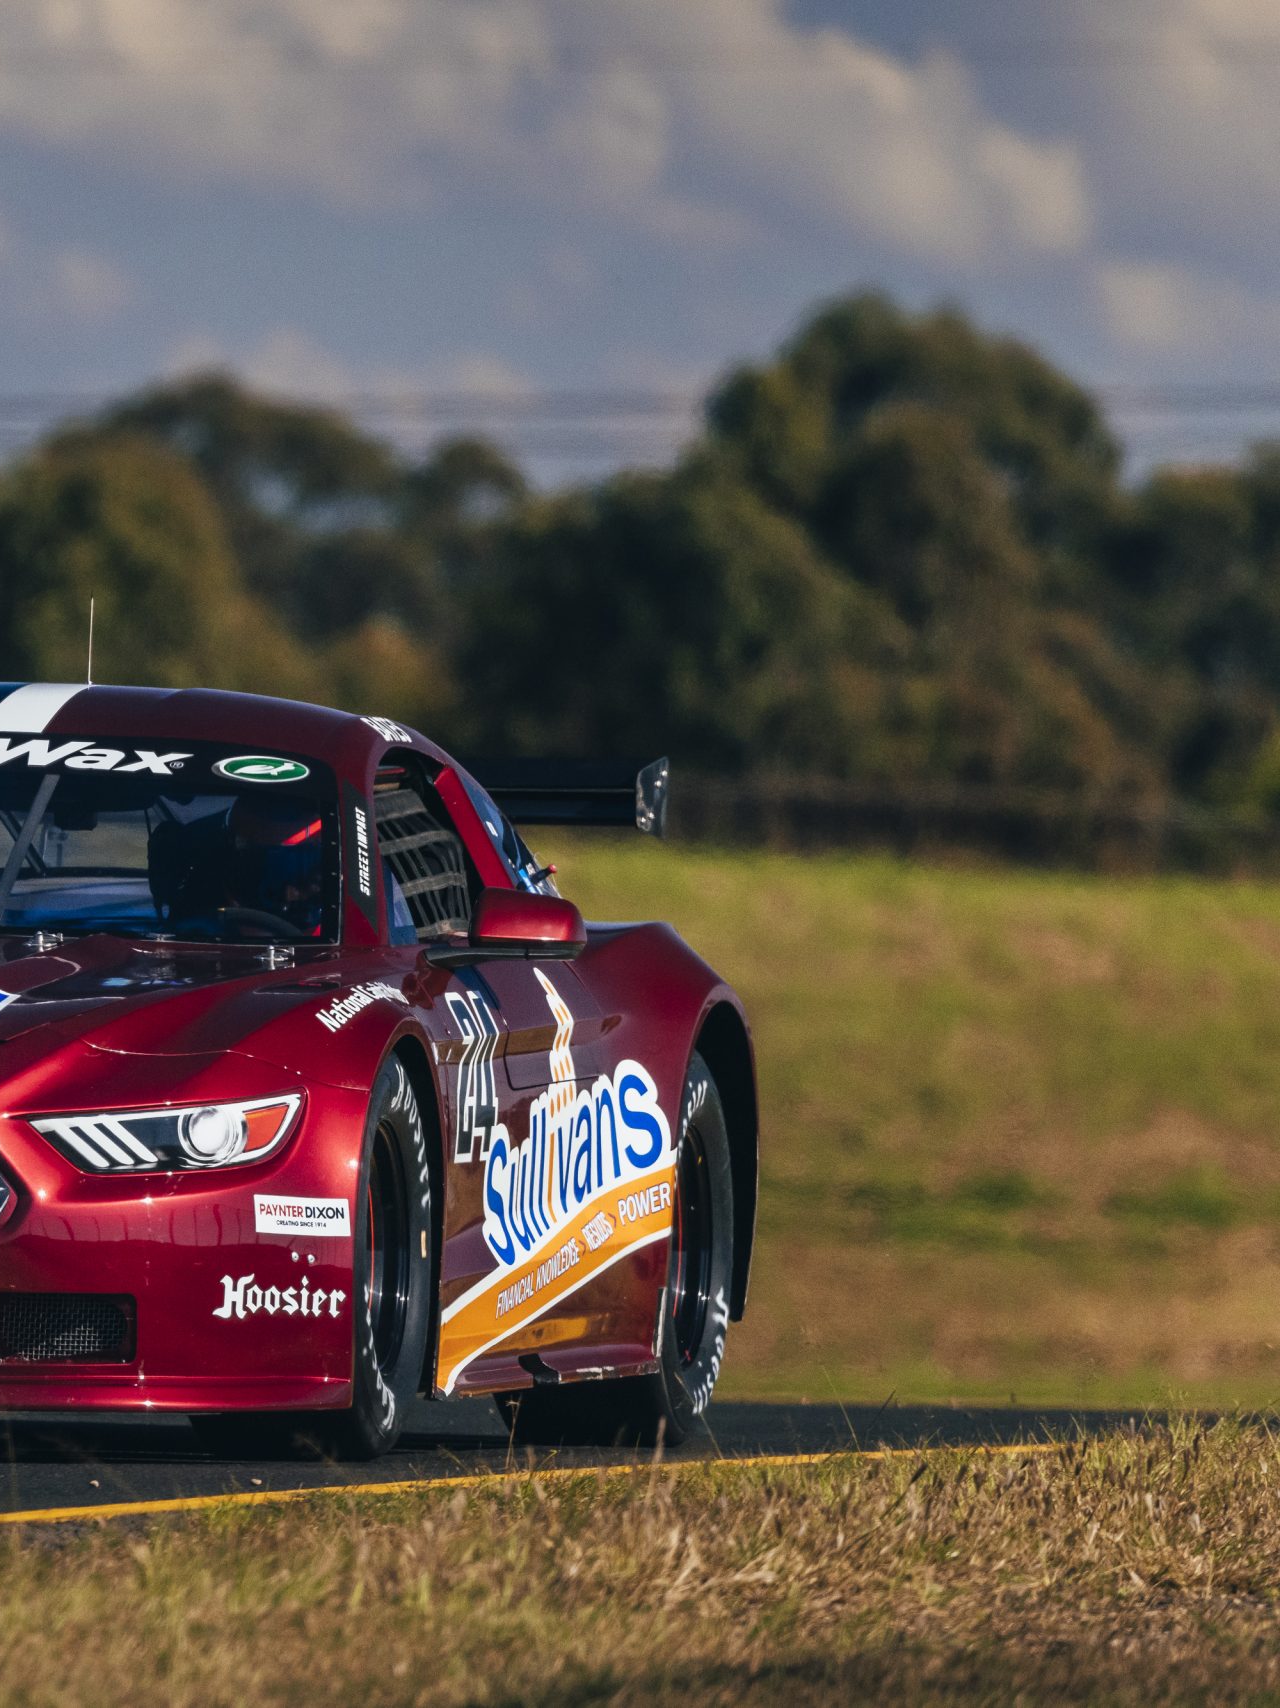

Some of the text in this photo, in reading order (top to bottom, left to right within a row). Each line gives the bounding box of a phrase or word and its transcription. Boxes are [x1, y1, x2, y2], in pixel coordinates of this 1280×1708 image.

[355, 806, 371, 896] STREET IMPACT
[315, 985, 375, 1033] National
[486, 1074, 664, 1266] Sullivans
[259, 1202, 345, 1220] PAYNTER DIXON
[495, 1270, 535, 1320] FINANCIAL
[535, 1237, 581, 1292] KNOWLEDGE
[618, 1181, 672, 1227] POWER
[212, 1273, 347, 1320] Hoosier
